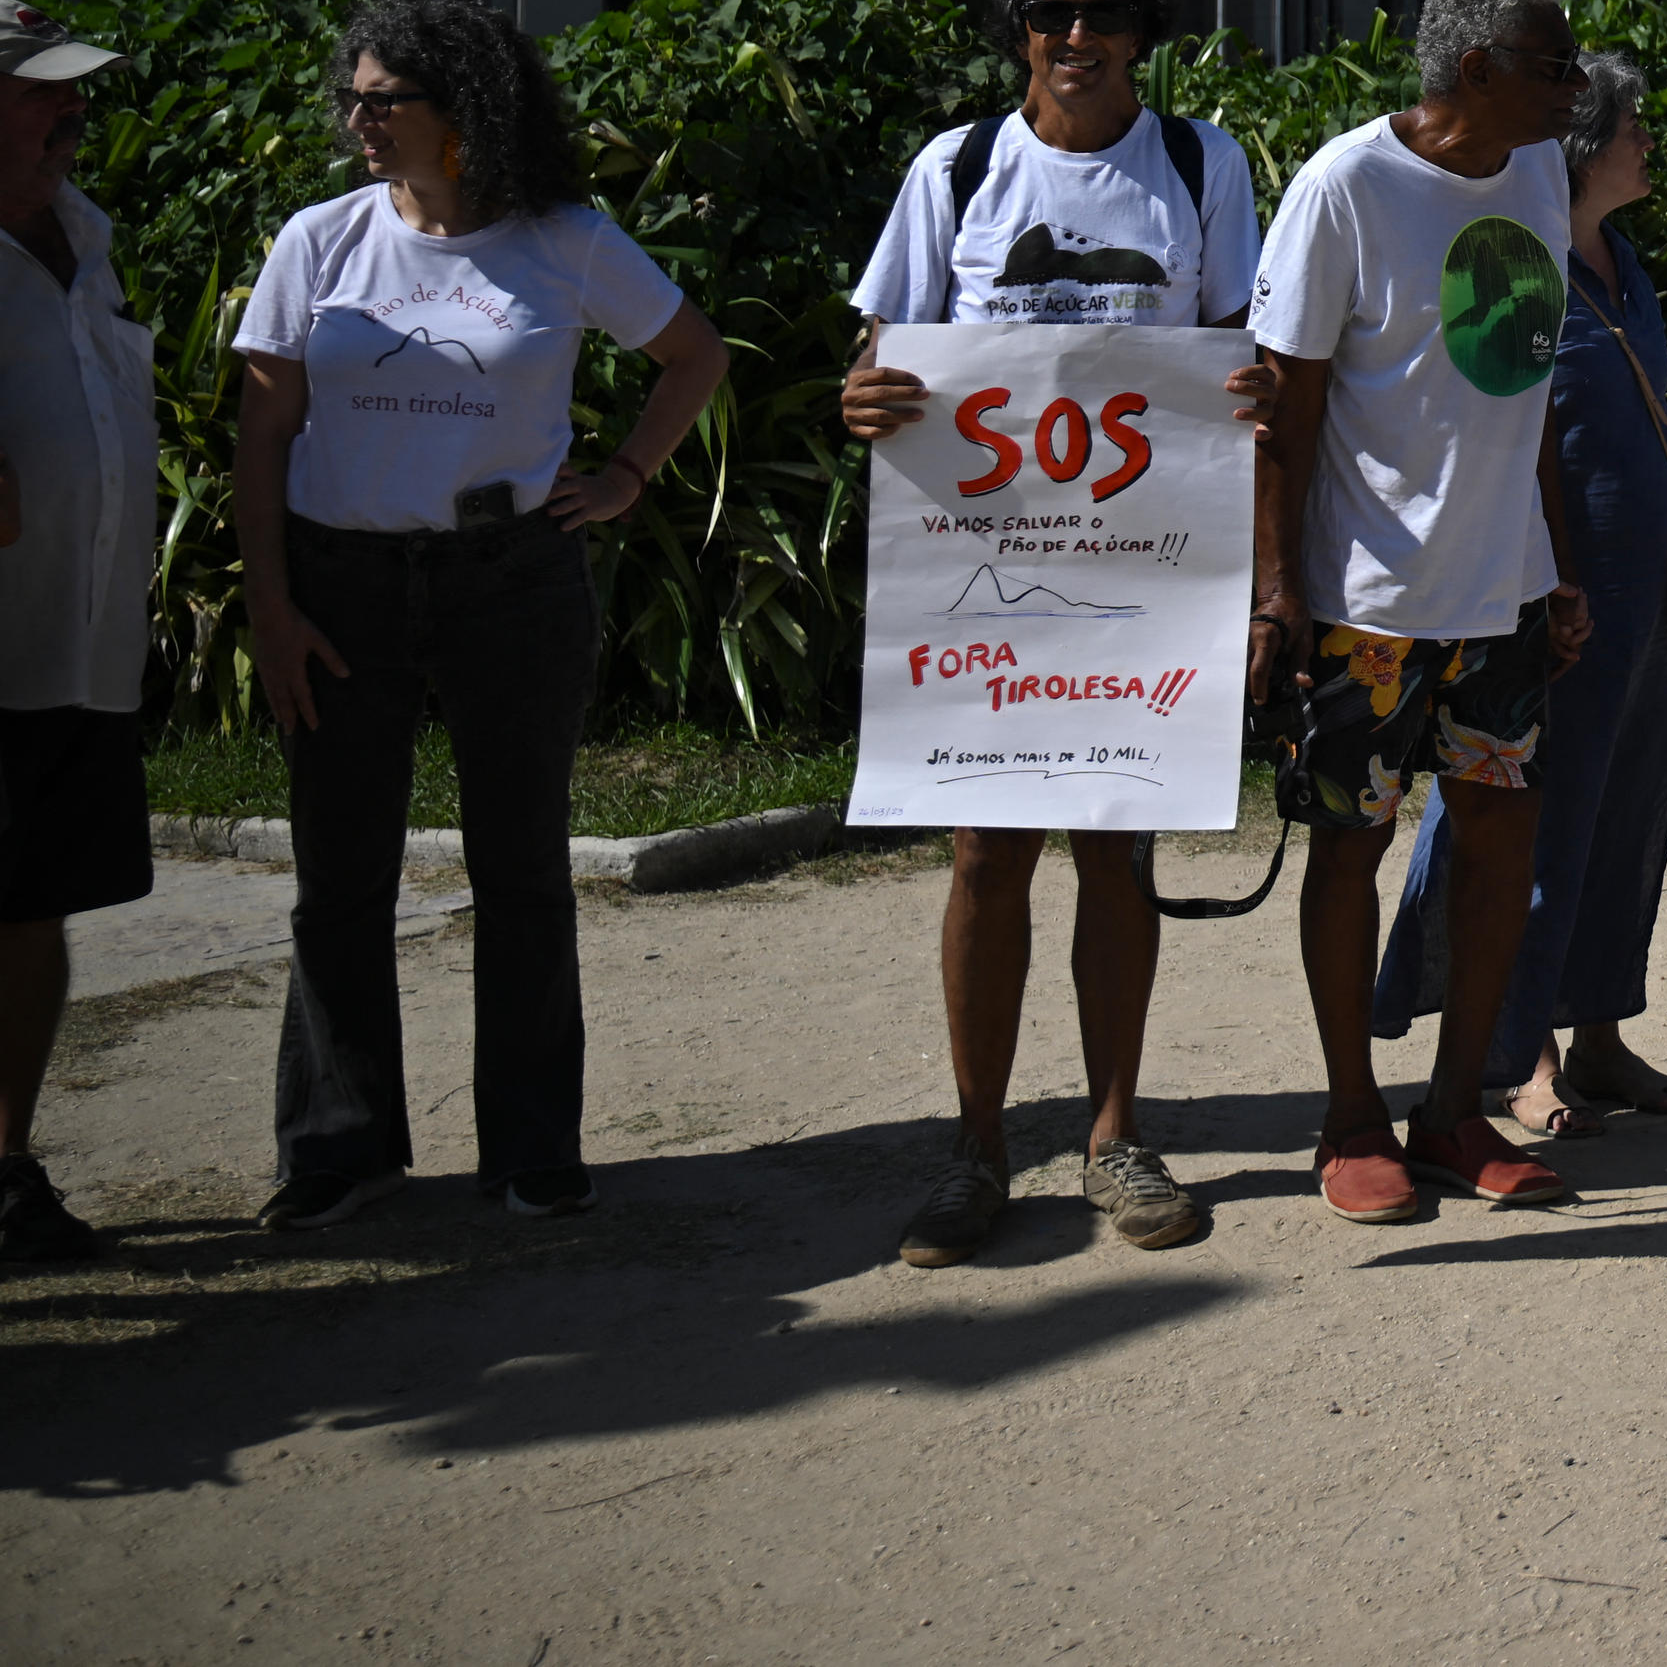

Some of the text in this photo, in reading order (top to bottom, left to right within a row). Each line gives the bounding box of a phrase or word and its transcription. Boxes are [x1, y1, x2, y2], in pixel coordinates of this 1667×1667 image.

[360, 283, 514, 332] Pão de Açúcar
[986, 291, 1165, 316] PÃO DE AÇÚCAR VERDE
[351, 392, 496, 418] sem tirolesa
[954, 387, 1152, 503] SOS
[922, 515, 994, 533] VAMOS
[1002, 515, 1082, 531] SALVAR
[998, 536, 1037, 555] PÃO
[1043, 538, 1067, 553] DE
[909, 641, 1017, 688] FORA
[926, 746, 954, 766] JÁ
[956, 751, 1006, 765] SOMOS
[1013, 751, 1051, 763] MAIS
[1057, 752, 1075, 763] DE
[1086, 746, 1109, 763] 10
